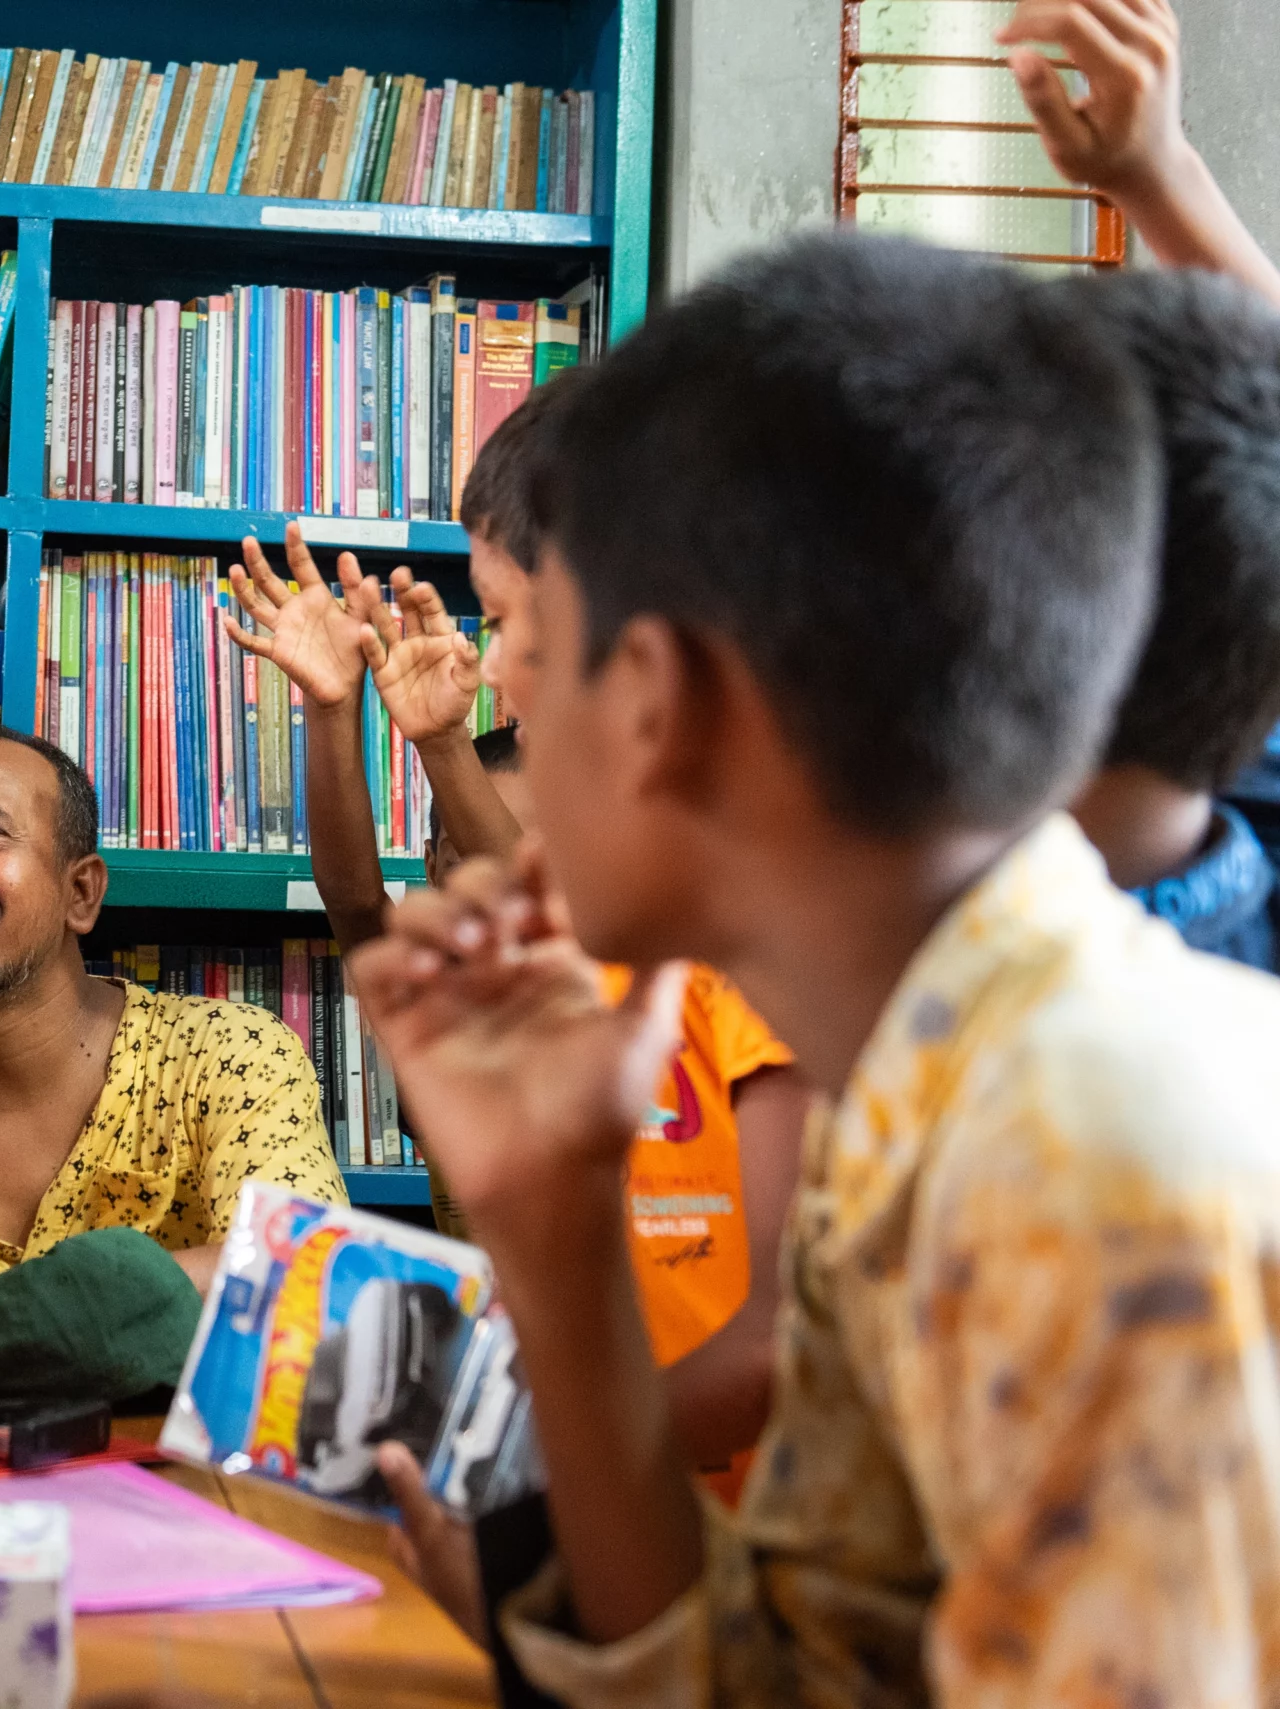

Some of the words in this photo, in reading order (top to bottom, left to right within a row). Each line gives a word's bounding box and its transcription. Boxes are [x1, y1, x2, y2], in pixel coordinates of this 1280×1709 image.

[364, 321, 373, 349] FAMILY
[185, 331, 193, 369] BARBARA
[363, 351, 373, 369] LAW
[481, 362, 511, 373] Directory
[184, 373, 193, 418] HEPWORTH
[460, 373, 469, 434] Introduction
[394, 752, 403, 786] Resource
[292, 983, 300, 1020] Pragmatics
[315, 995, 324, 1020] WHEN
[315, 1021, 324, 1038] THE
[334, 1013, 342, 1032] Internet
[315, 1040, 324, 1066] HEAT'S
[335, 1051, 343, 1073] Language
[315, 1068, 324, 1080] ON
[336, 1074, 344, 1100] Classroom
[385, 1098, 394, 1121] White
